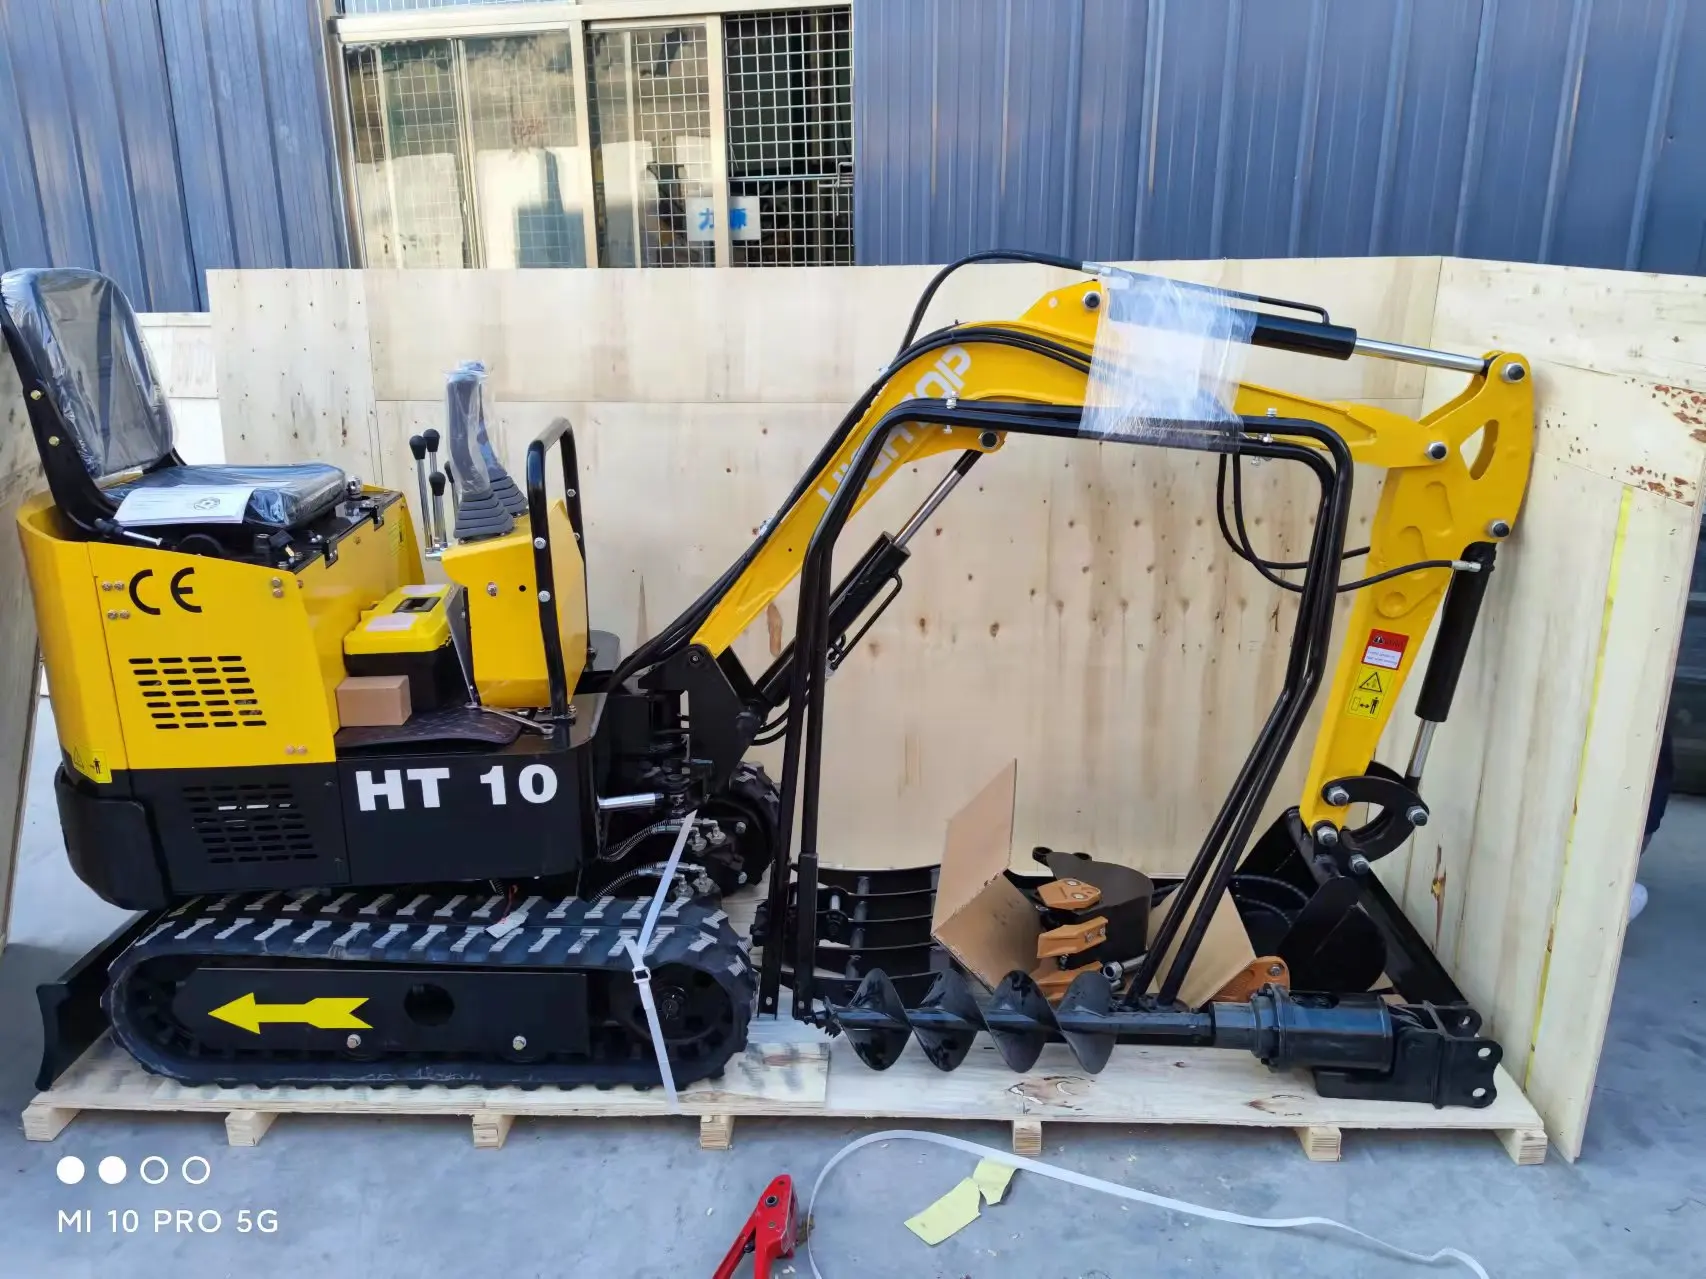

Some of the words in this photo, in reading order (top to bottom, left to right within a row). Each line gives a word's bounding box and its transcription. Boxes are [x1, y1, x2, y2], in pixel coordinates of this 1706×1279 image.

[129, 567, 202, 615] CE
[355, 767, 450, 811] HT
[479, 763, 558, 805] 10
